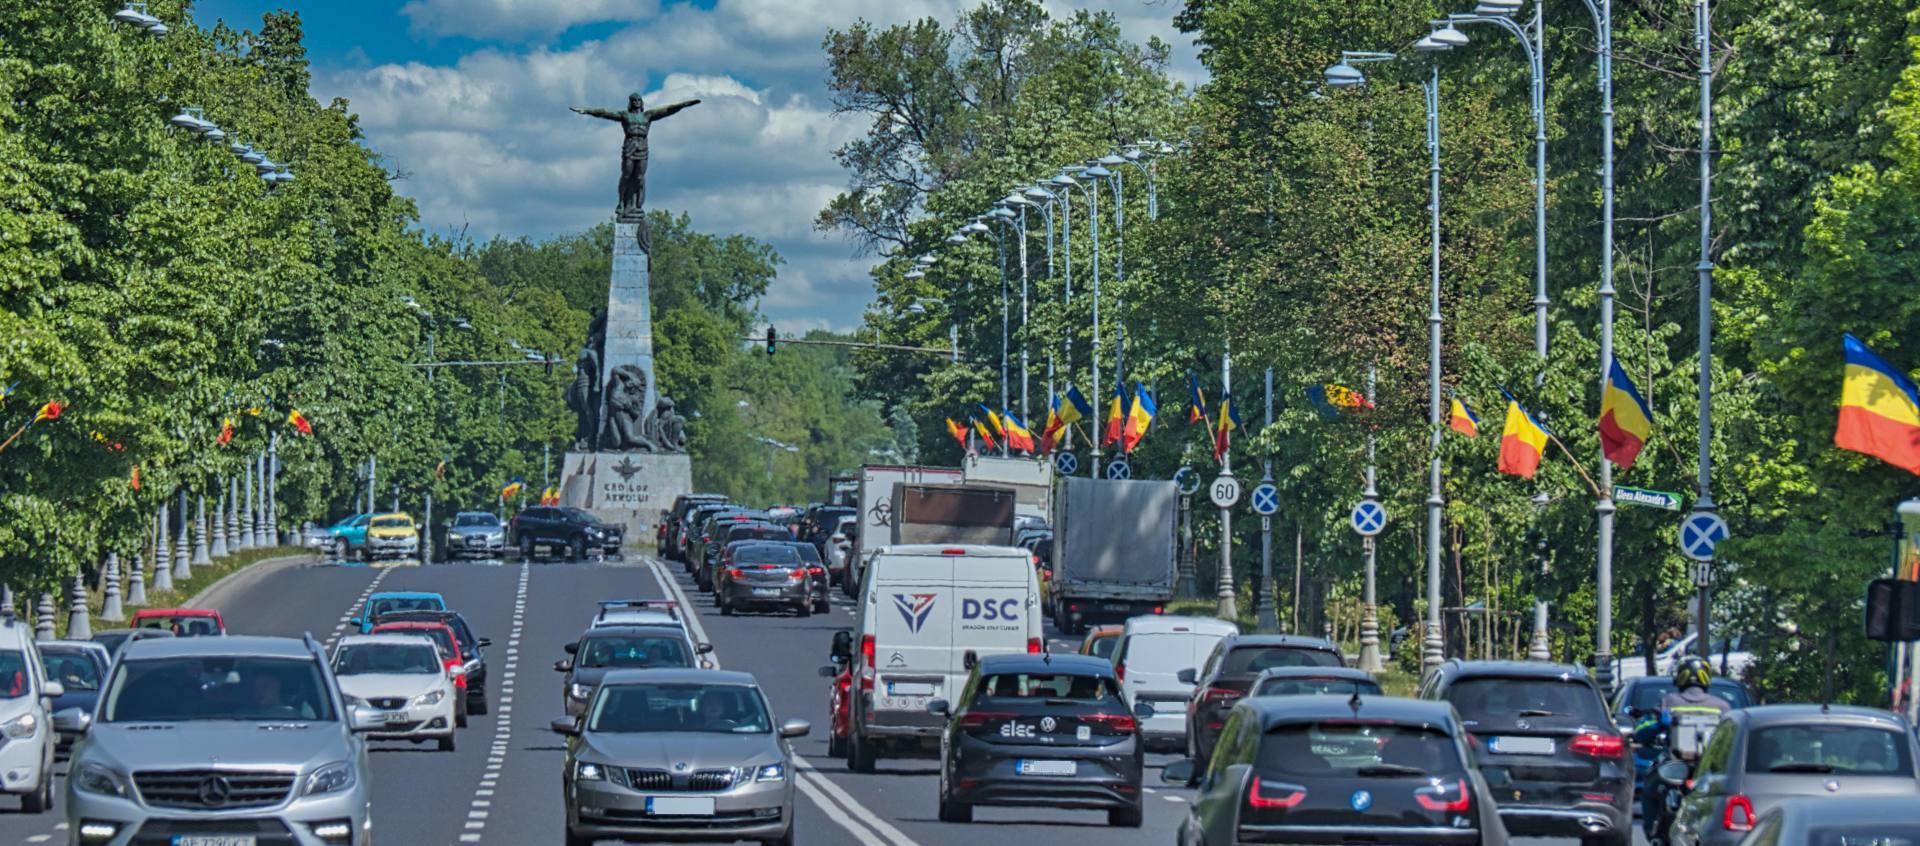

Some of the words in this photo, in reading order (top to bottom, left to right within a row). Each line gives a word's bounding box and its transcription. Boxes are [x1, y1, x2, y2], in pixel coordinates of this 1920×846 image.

[1216, 483, 1234, 500] 60
[962, 598, 1019, 620] DSC
[1000, 719, 1036, 737] elec
